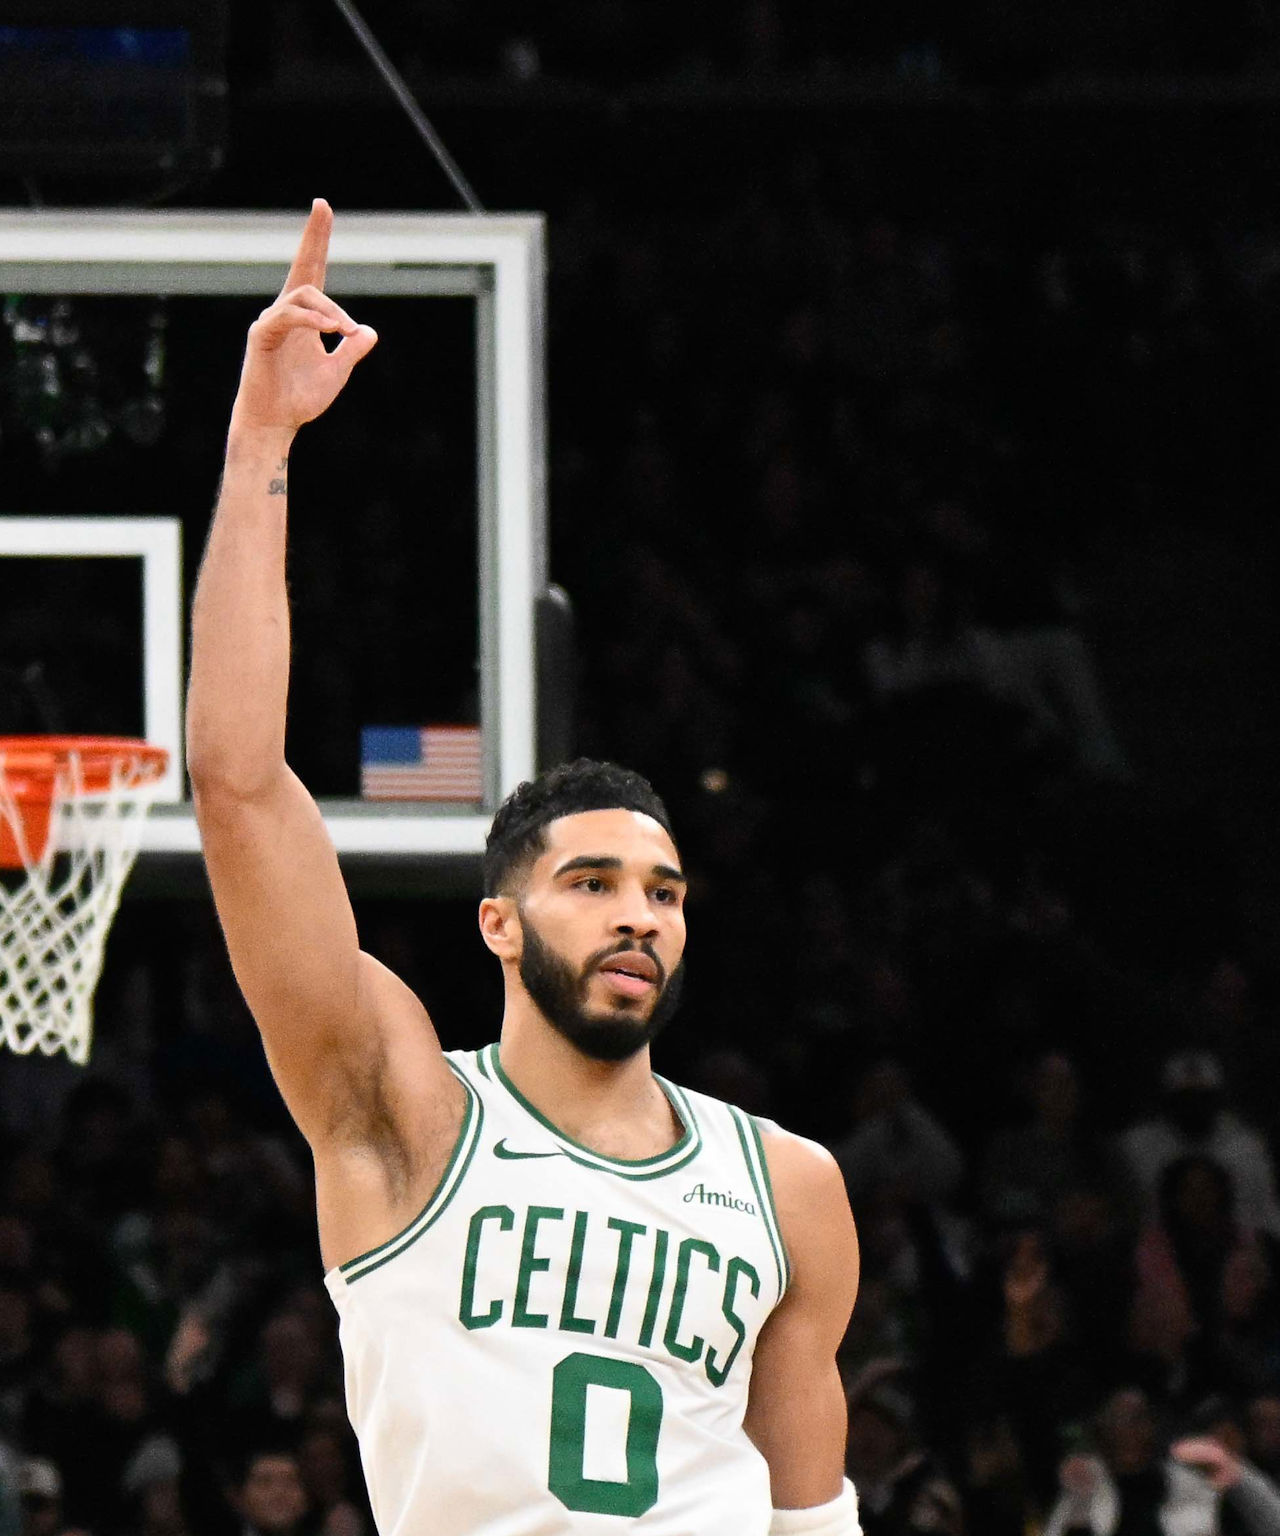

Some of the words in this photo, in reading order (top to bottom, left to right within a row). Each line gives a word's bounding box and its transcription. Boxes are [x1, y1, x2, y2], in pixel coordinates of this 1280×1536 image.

[682, 1183, 756, 1216] Amica
[459, 1204, 761, 1388] CELTICS
[548, 1352, 663, 1518] 0
